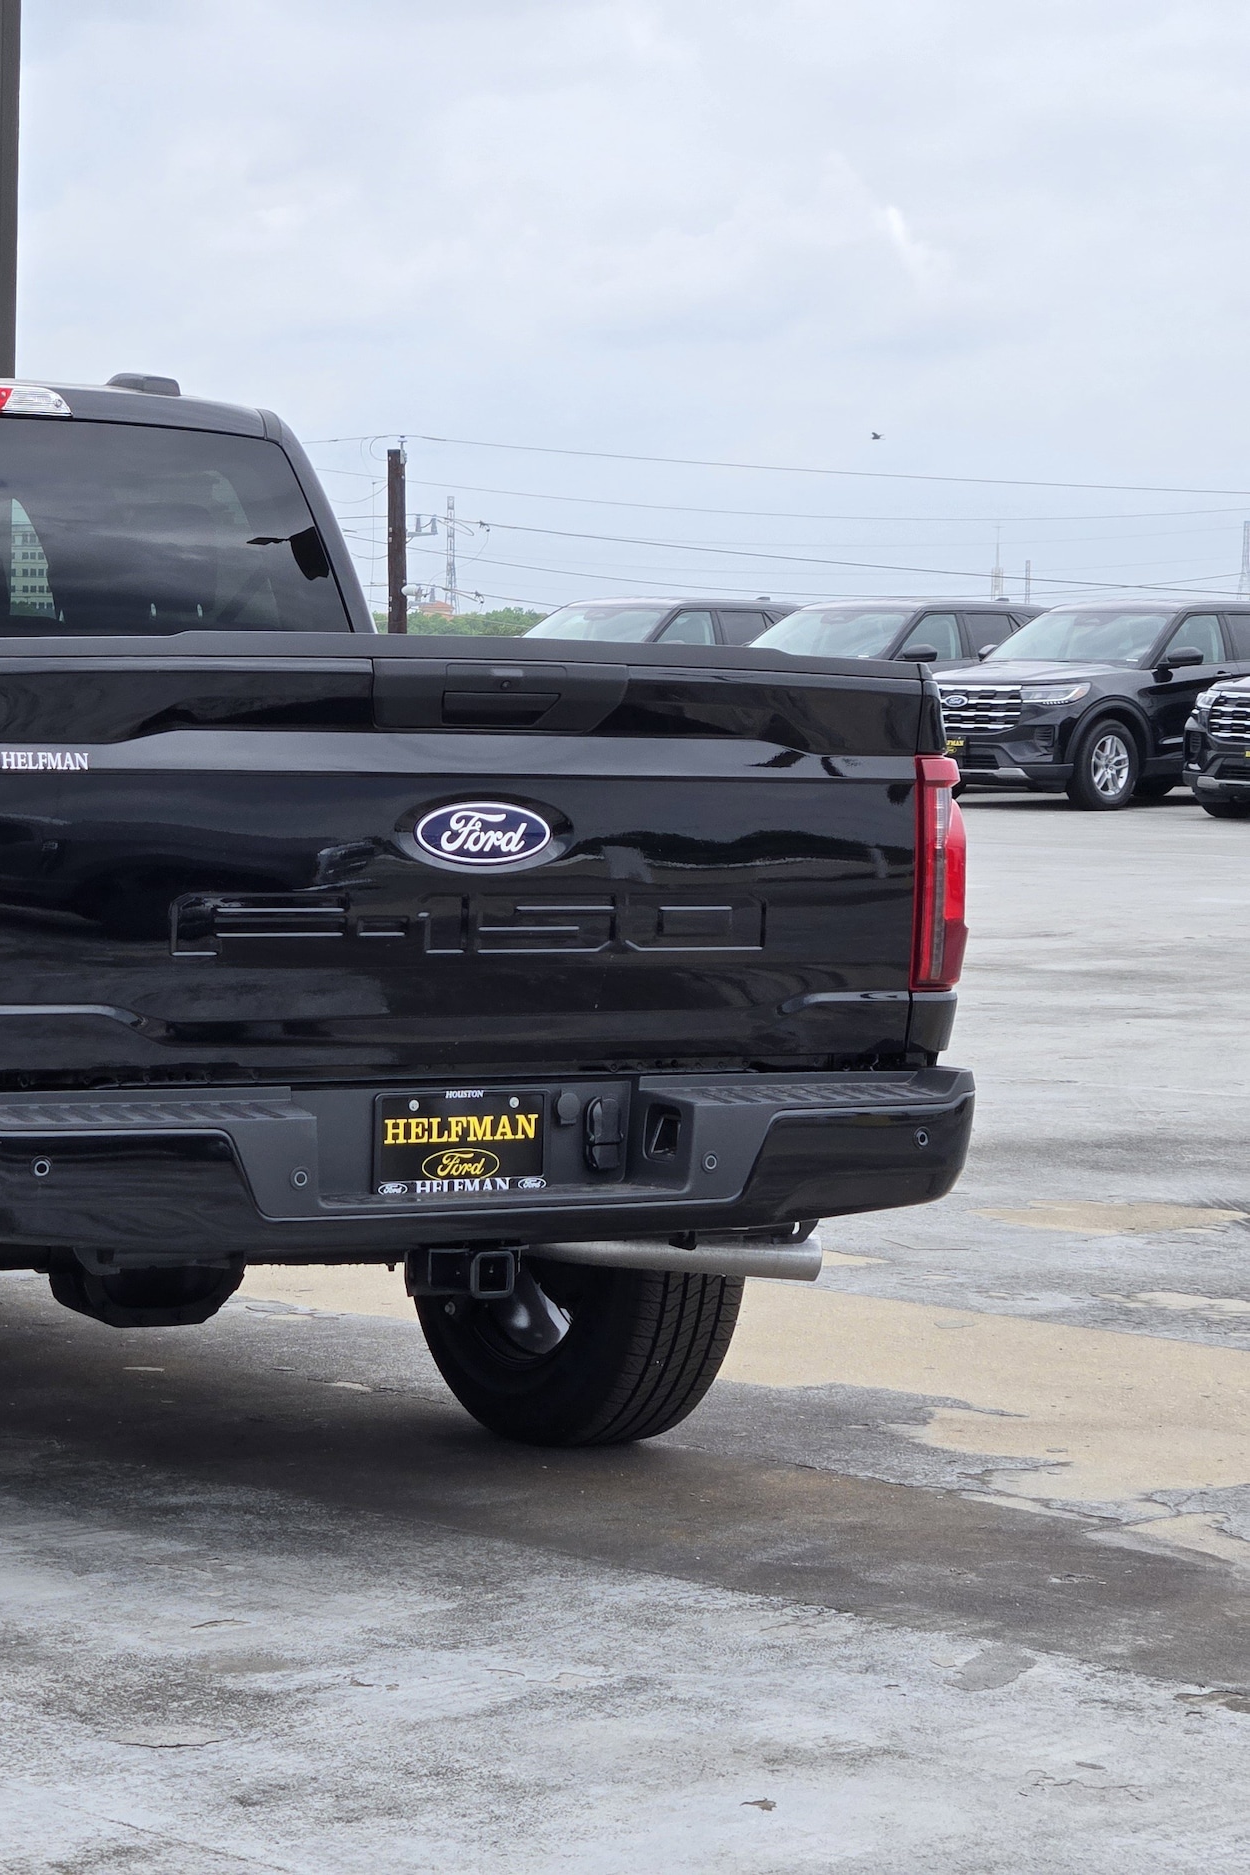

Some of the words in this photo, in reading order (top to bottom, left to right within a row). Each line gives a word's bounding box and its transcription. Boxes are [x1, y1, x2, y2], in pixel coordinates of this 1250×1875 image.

[1, 752, 89, 770] HELFMAN
[440, 811, 528, 852] Ford
[169, 892, 766, 956] F-150
[445, 1090, 484, 1098] HOUSTON
[384, 1114, 539, 1144] HELFMAN
[437, 1152, 486, 1176] Ford
